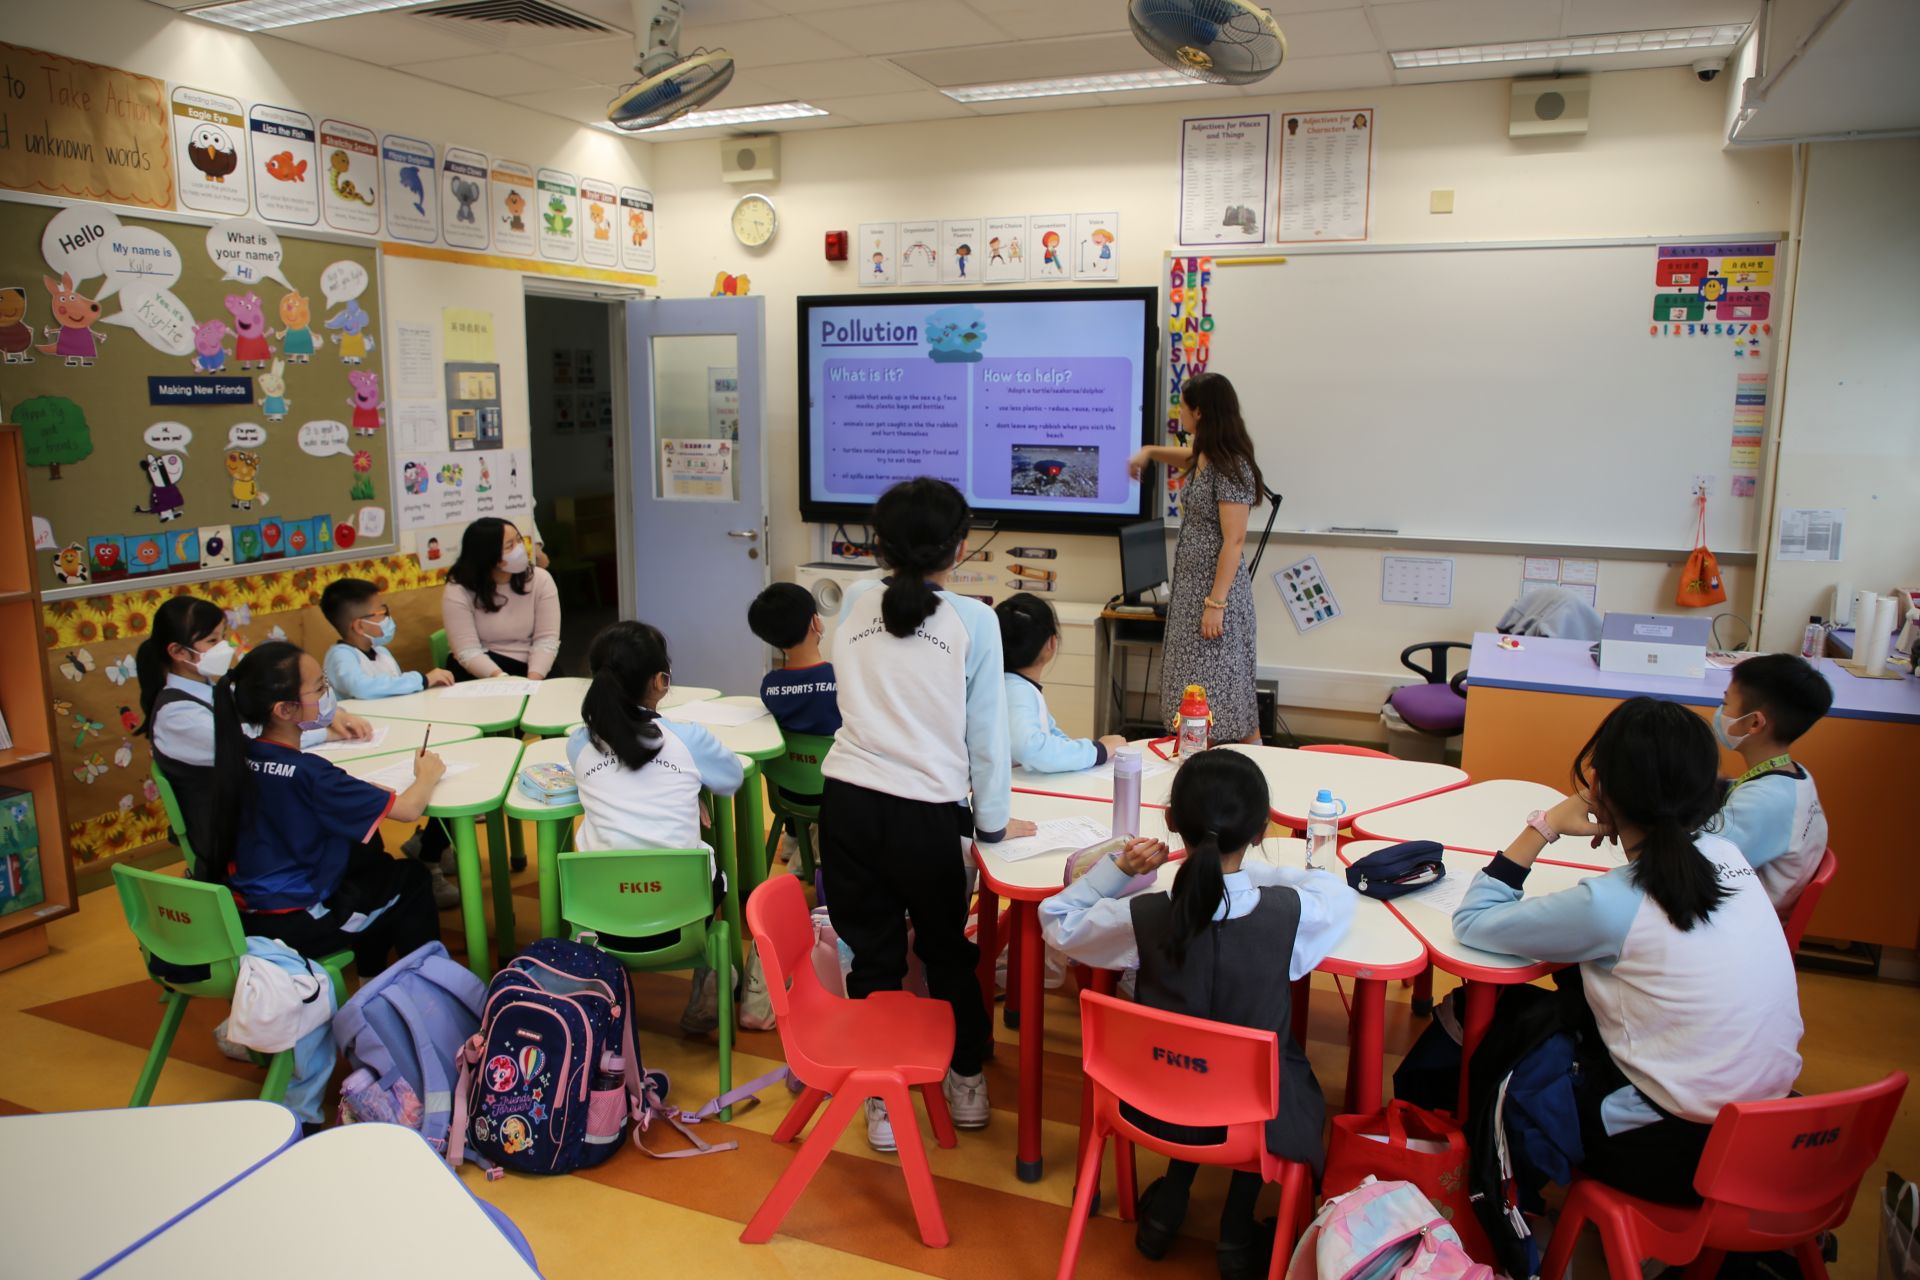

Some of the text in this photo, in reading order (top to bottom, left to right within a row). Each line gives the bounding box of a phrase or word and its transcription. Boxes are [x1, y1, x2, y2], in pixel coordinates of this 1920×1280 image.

[3, 64, 150, 121] to Take Action
[188, 107, 229, 124] Eagle Eye
[1303, 115, 1350, 126] Adjectives for
[262, 123, 306, 139] Lips the Fish
[1191, 121, 1261, 132] Adjectives for Places
[1307, 126, 1345, 134] Characters
[1222, 131, 1244, 140] Things
[25, 119, 151, 171] unknown words
[58, 224, 105, 254] Hello
[227, 232, 267, 246] What is
[112, 243, 172, 257] My name is
[216, 248, 281, 262] your name?
[237, 265, 253, 279] Hi
[822, 319, 918, 343] Pollution
[830, 367, 904, 382] What is it?
[984, 368, 1072, 386] How to help?
[159, 384, 246, 397] Making New Friends
[1022, 405, 1042, 413] plastic
[1091, 406, 1114, 414] recycle
[849, 625, 952, 655] INNOVA CHOOL
[766, 686, 779, 696] FKIS
[780, 683, 814, 696] SPORTS
[788, 752, 817, 765] FKIS
[263, 761, 297, 777] TEAM
[583, 757, 682, 780] INNOVA HOOL
[619, 881, 663, 894] FKIS
[158, 906, 192, 925] FKIS
[1153, 1046, 1208, 1074] FKIS
[1791, 1127, 1841, 1150] FKIS
